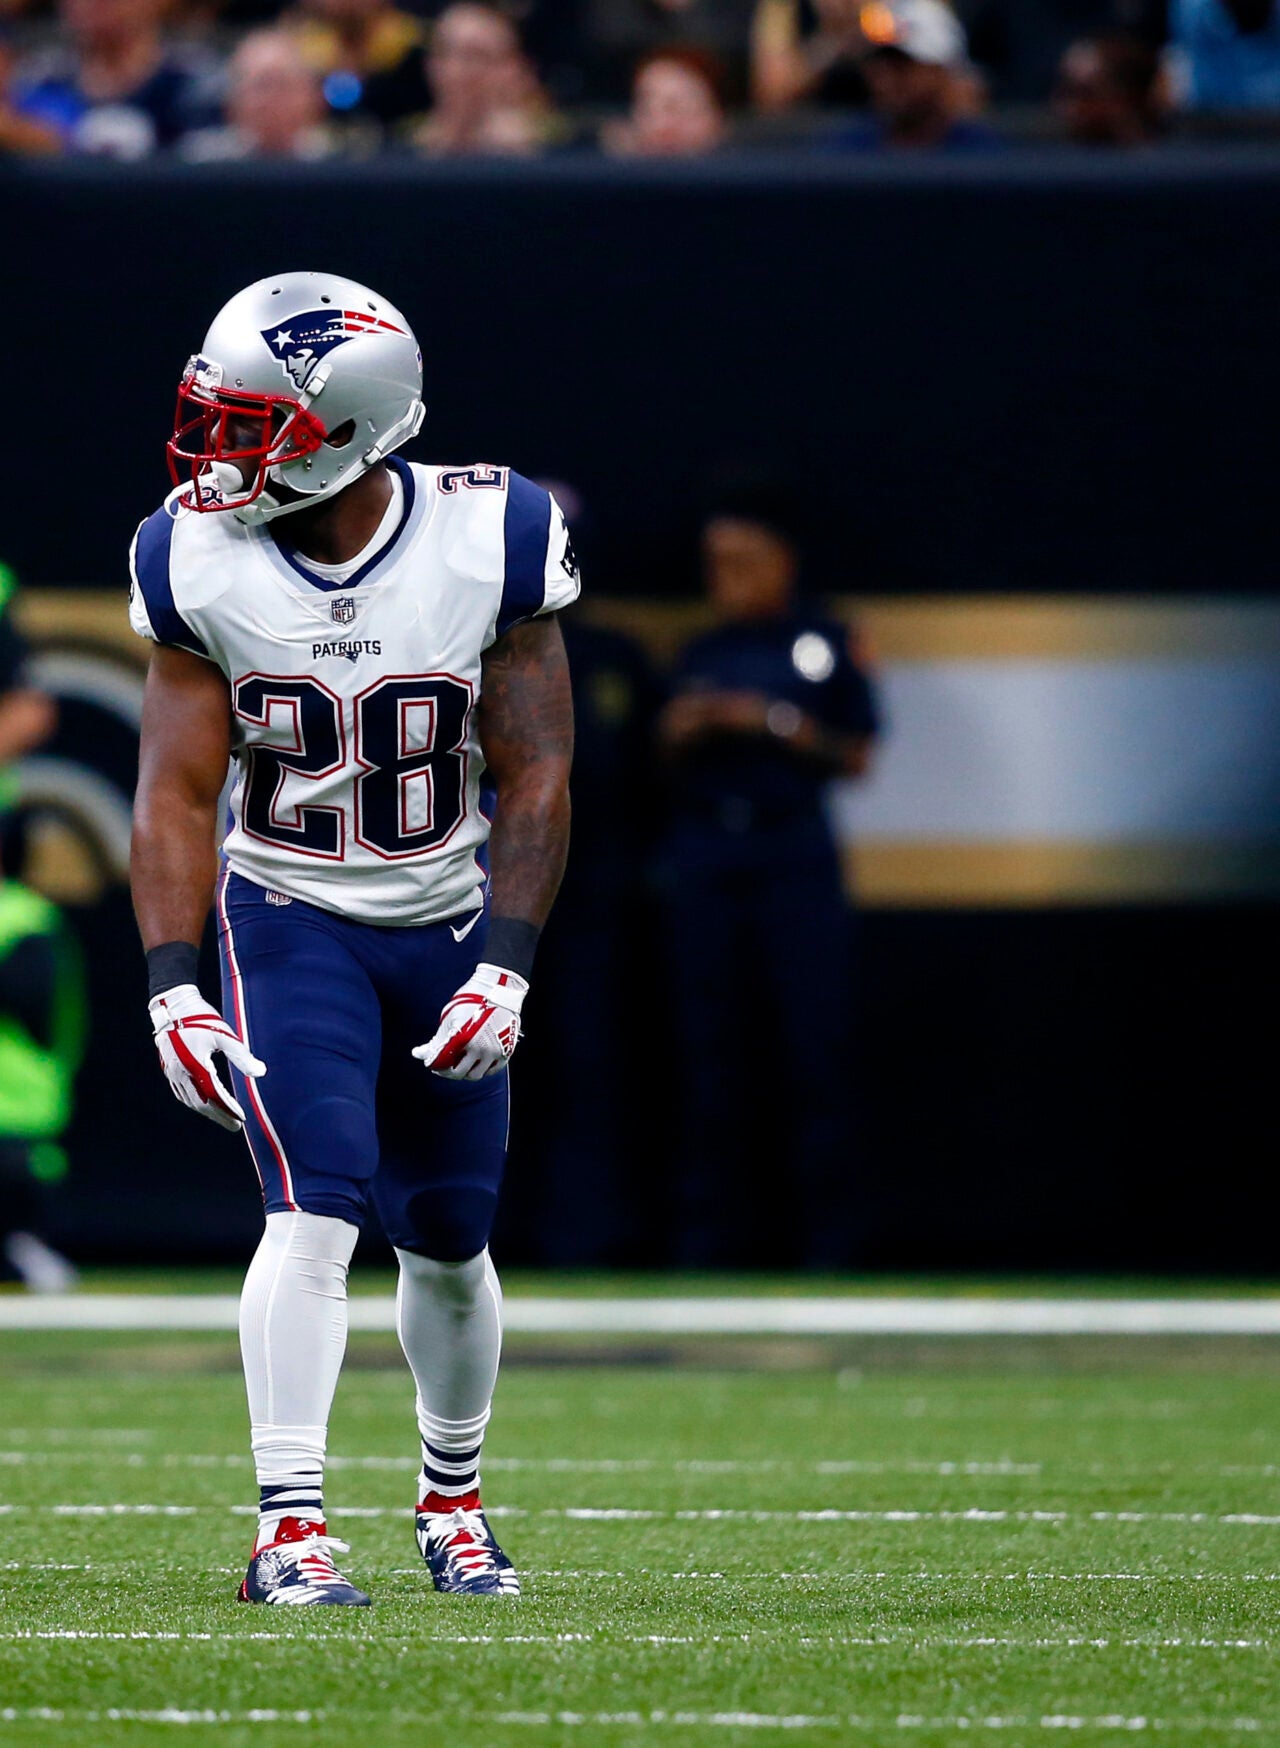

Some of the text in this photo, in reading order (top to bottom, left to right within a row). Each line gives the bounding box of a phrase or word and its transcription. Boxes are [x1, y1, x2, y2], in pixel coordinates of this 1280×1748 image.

[334, 608, 353, 620] NFL
[312, 640, 382, 660] PATRIOTS
[233, 671, 473, 862] 28
